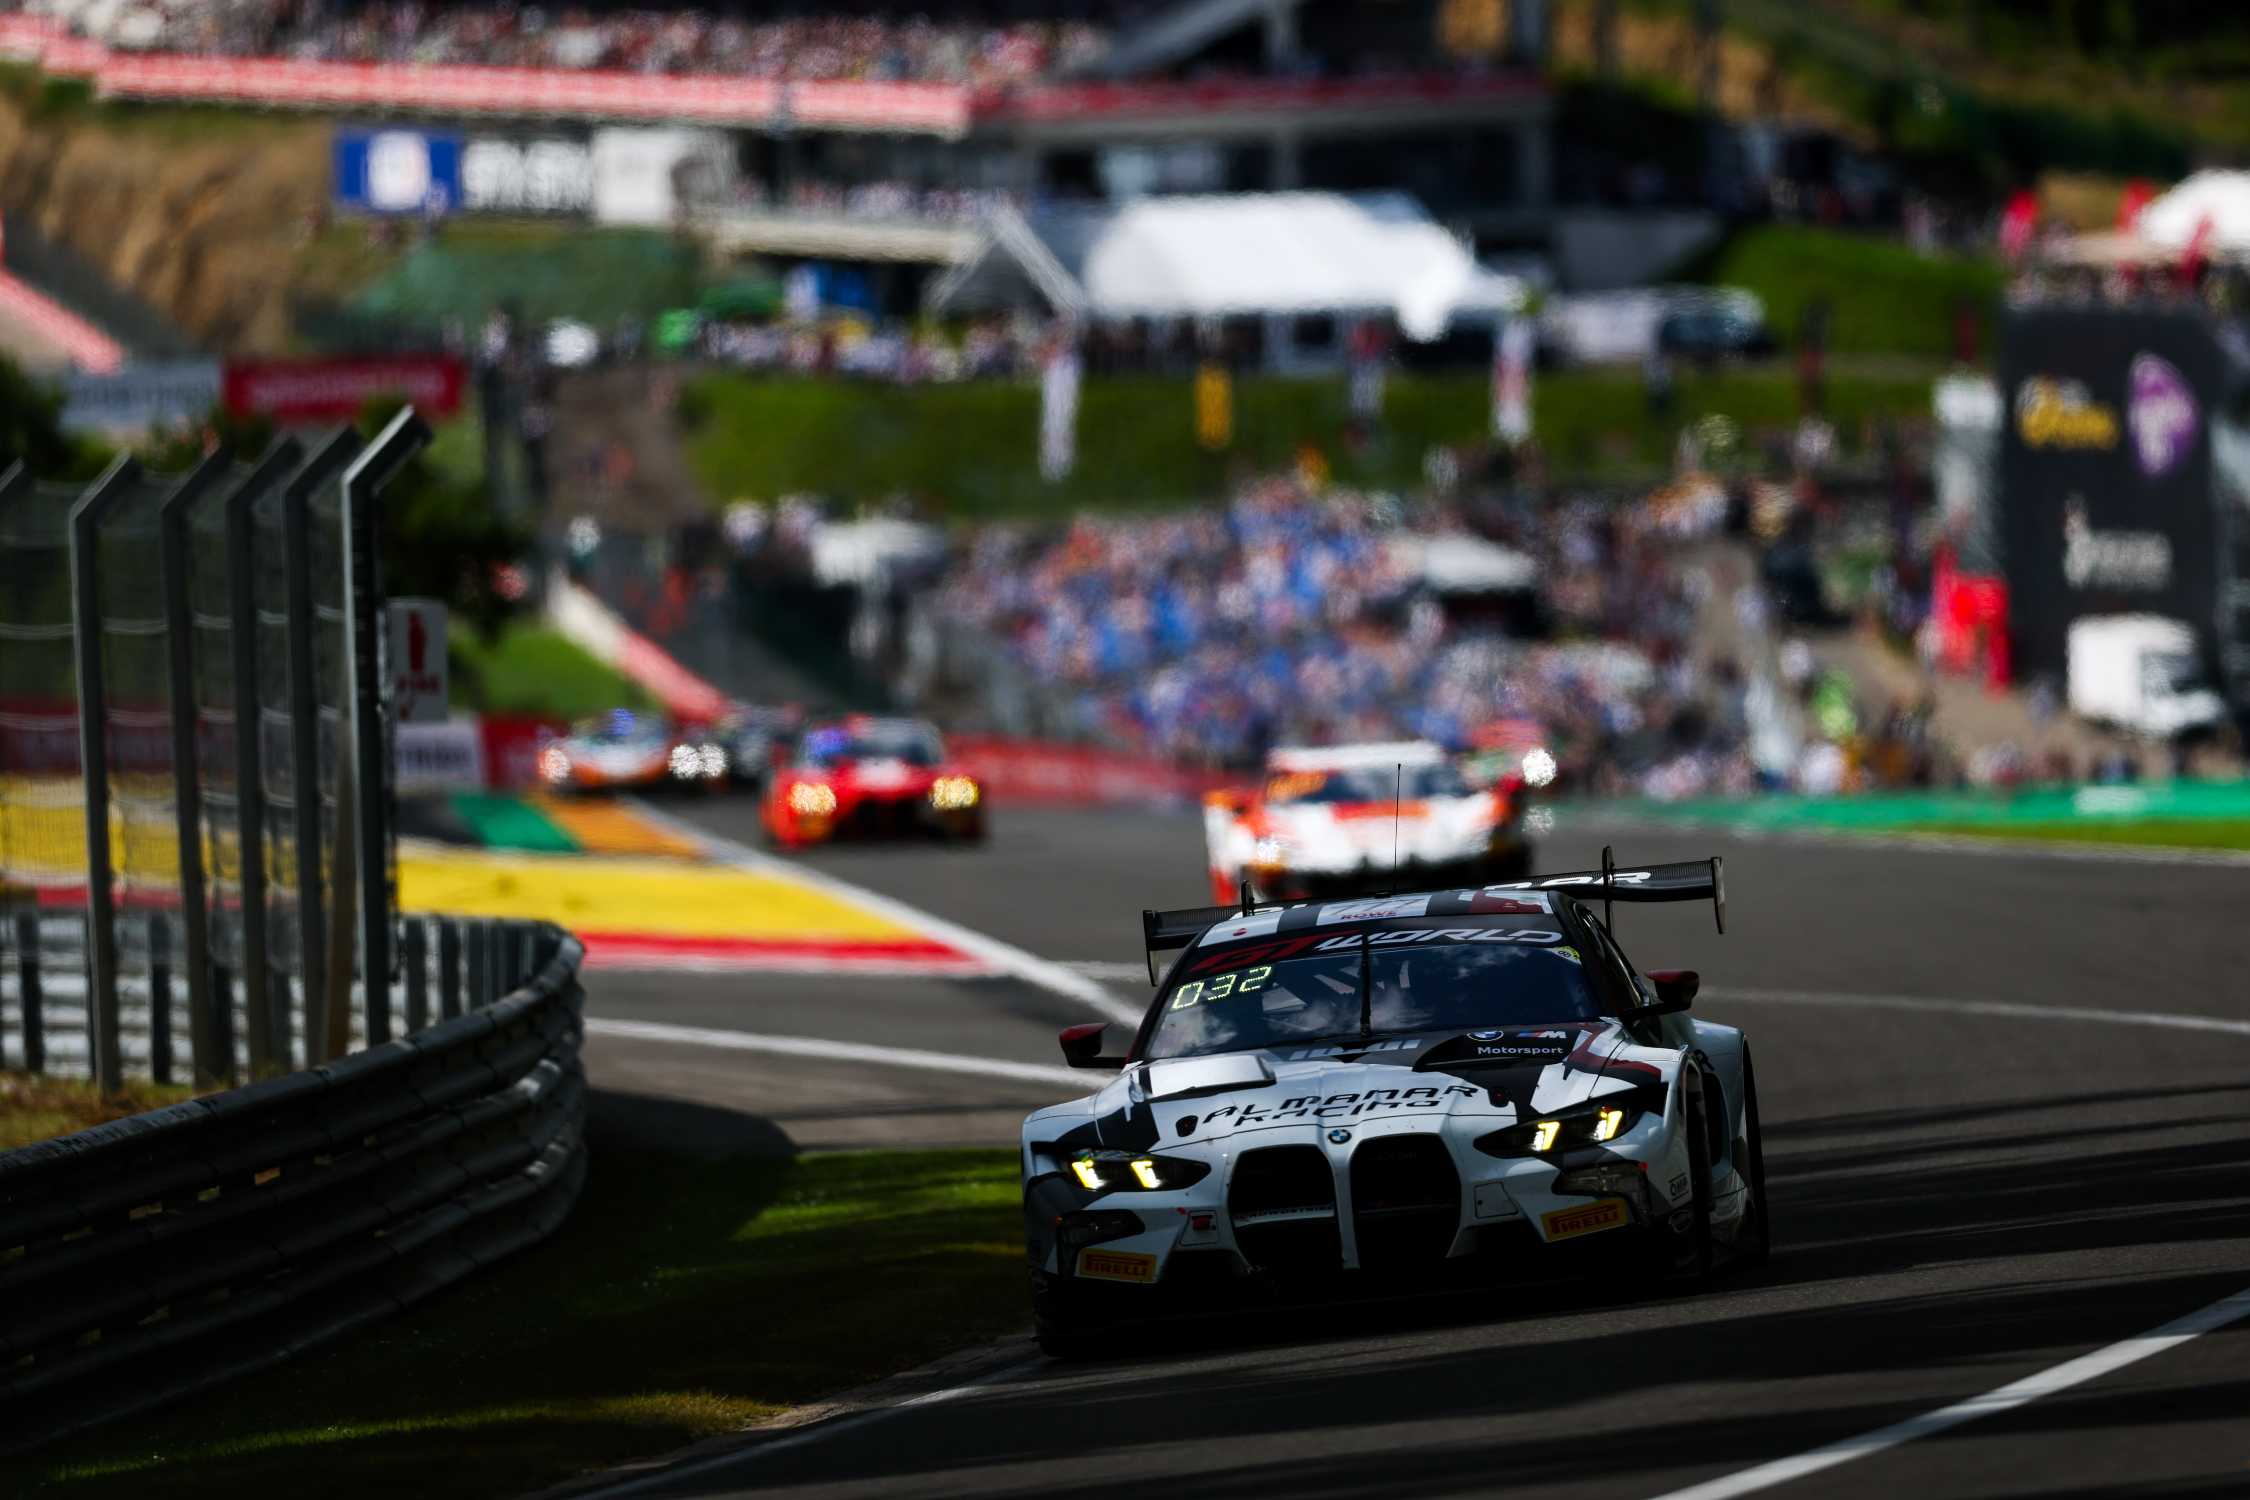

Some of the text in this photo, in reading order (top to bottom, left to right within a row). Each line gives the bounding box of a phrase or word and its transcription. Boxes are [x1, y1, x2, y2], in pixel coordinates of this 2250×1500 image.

[1188, 929, 1563, 974] GT WORLD
[1171, 966, 1272, 1010] 032
[1476, 1046, 1564, 1056] Motorsport
[1202, 1085, 1478, 1124] ALMANAR
[1551, 1203, 1619, 1233] PIRELLI
[1086, 1254, 1149, 1277] PIRELLI
